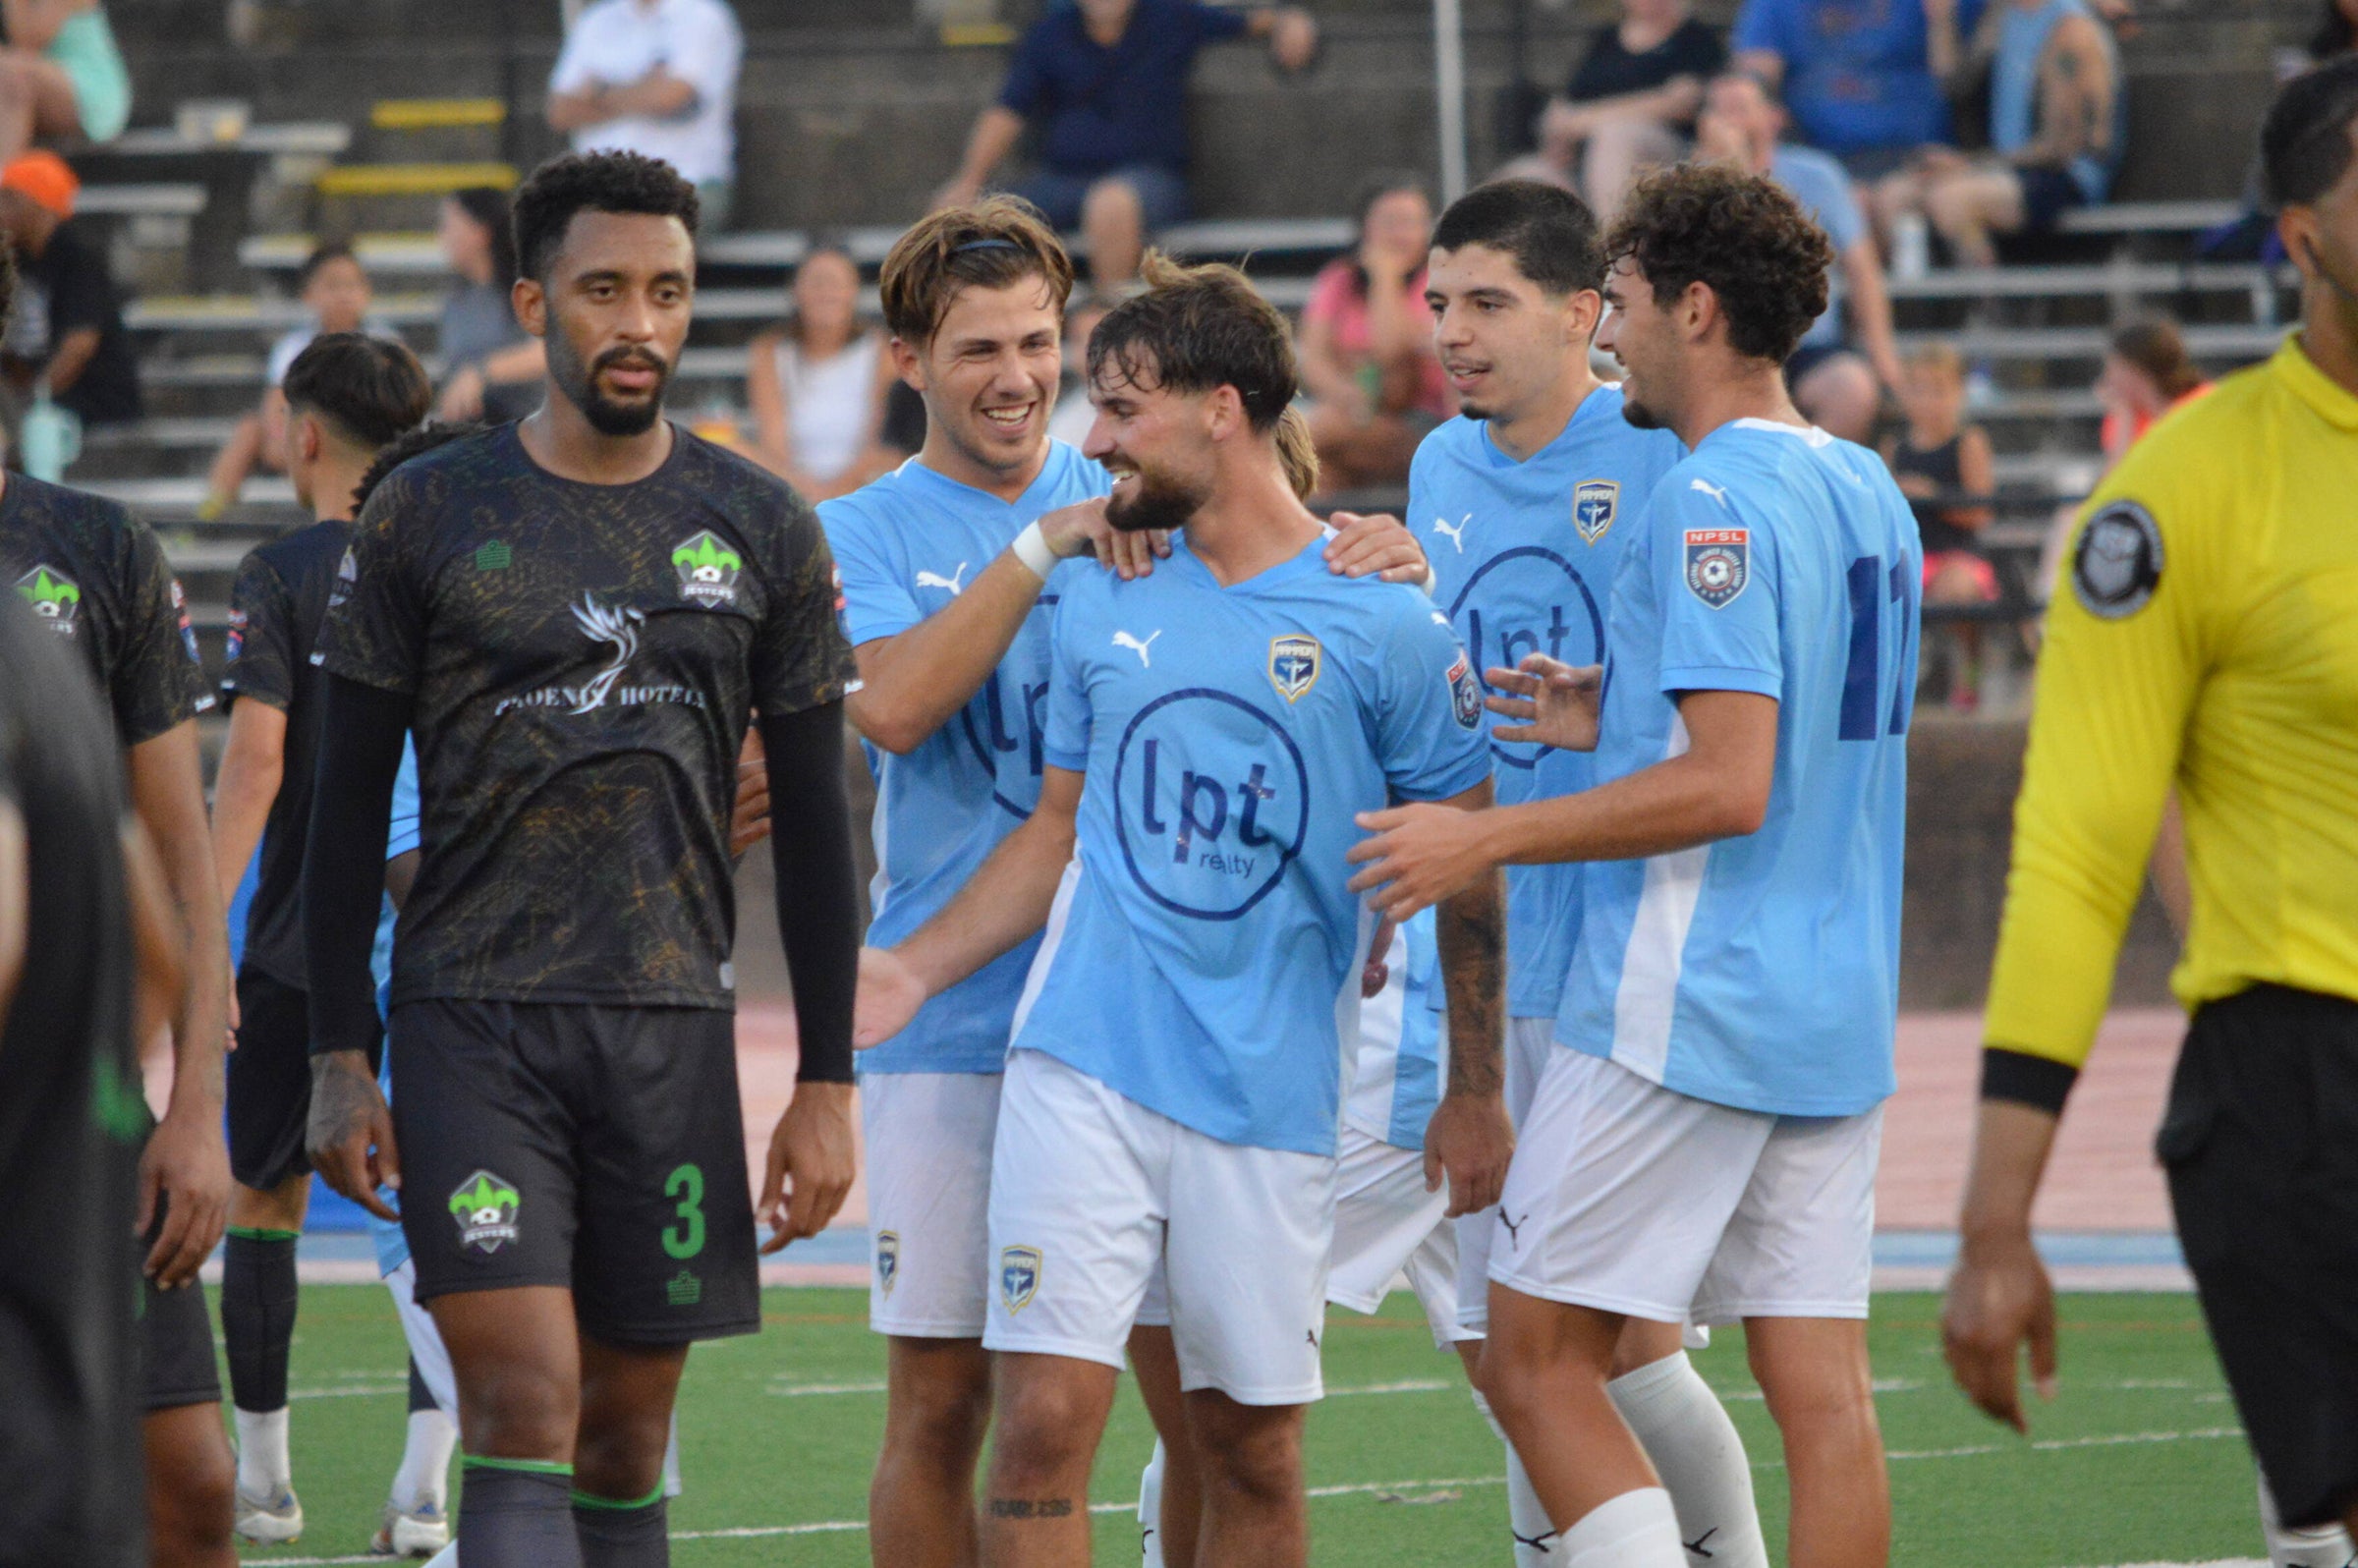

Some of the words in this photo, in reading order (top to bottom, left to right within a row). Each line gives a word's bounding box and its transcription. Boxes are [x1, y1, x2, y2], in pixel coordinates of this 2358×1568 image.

[1690, 532, 1743, 541] NPSL
[684, 587, 733, 600] JESTERS
[1274, 643, 1316, 657] ARMADA
[1836, 547, 1912, 742] 11
[1143, 739, 1276, 866] lpt
[1199, 850, 1257, 879] realty
[660, 1161, 706, 1260] 3
